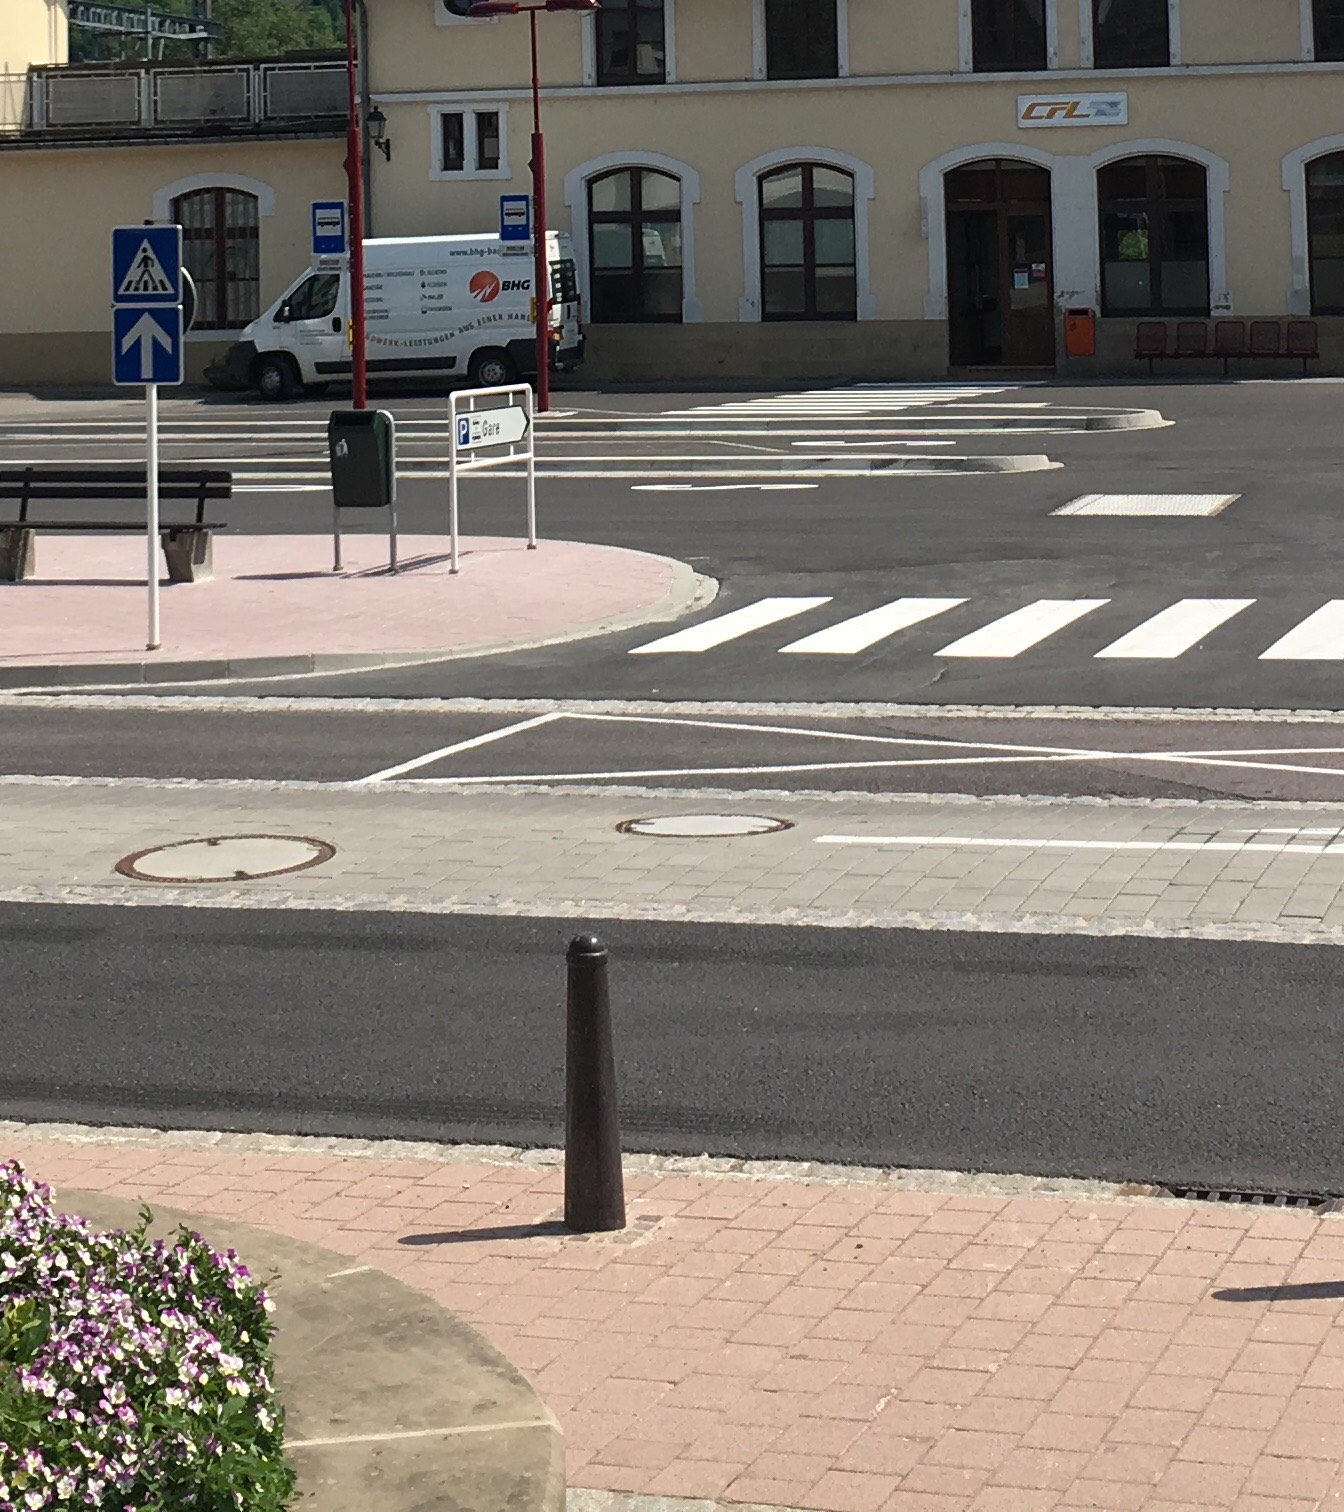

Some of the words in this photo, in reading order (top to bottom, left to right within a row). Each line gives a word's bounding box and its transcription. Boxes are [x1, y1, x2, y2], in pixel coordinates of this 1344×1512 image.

[1021, 101, 1091, 120] CFL
[449, 247, 499, 257] www.bhg-ba
[501, 279, 531, 291] BHG
[460, 420, 468, 443] P
[482, 419, 501, 438] Gare
